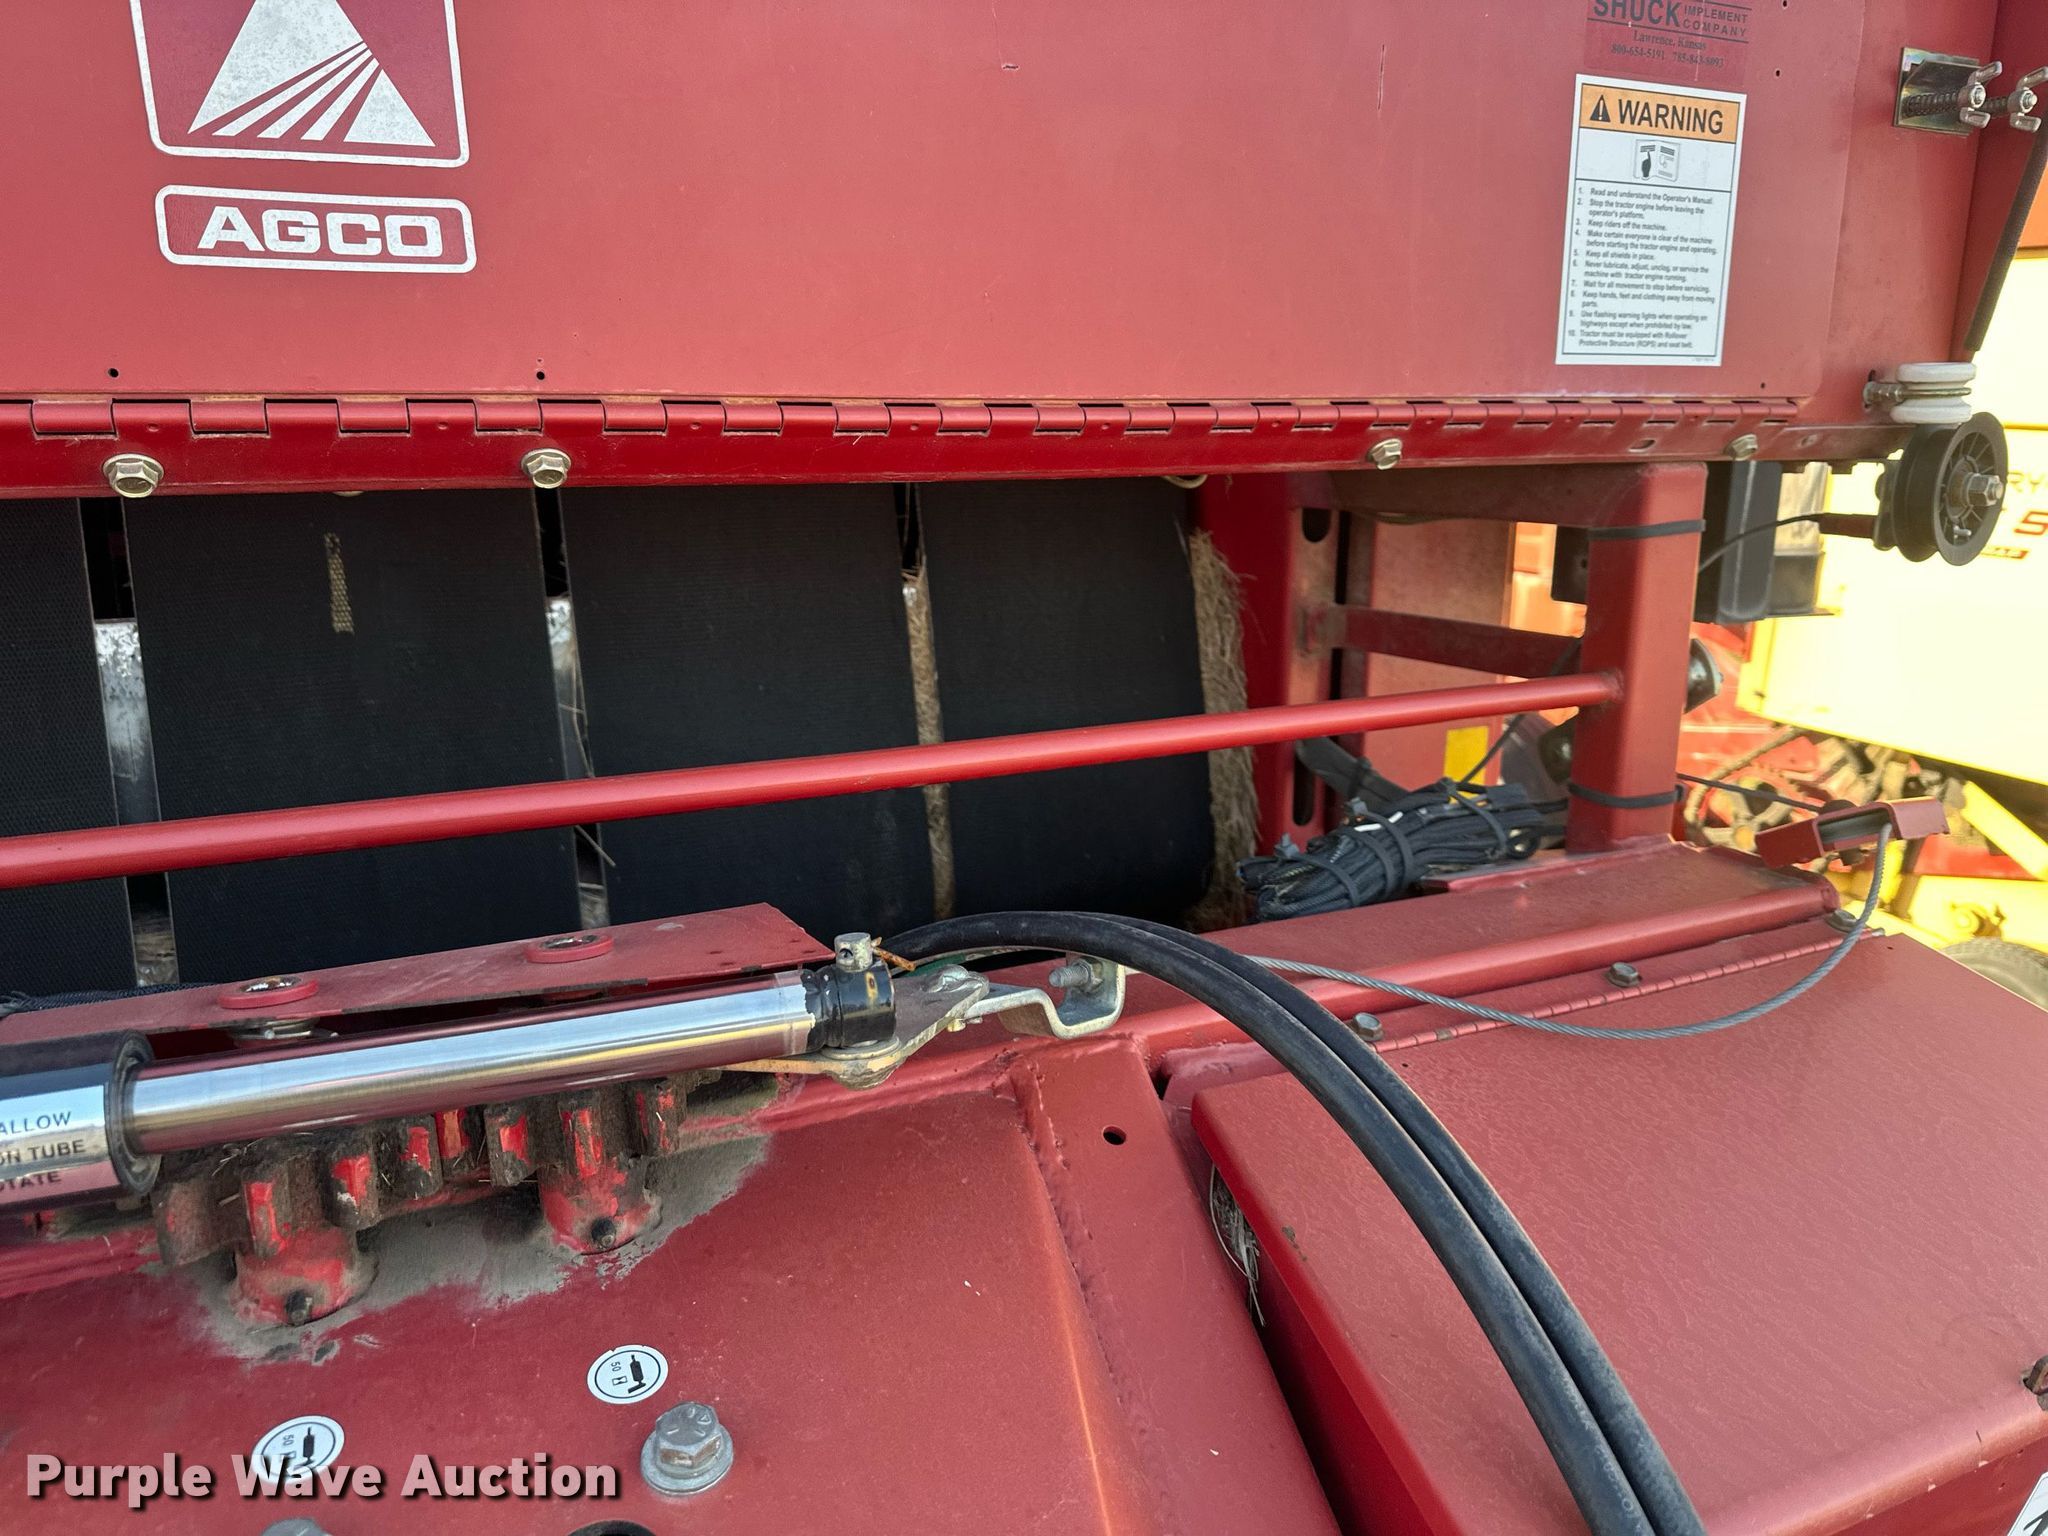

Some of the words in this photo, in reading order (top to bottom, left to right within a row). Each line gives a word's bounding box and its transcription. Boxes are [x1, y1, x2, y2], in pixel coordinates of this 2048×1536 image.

[1594, 0, 1680, 27] SHUCK
[1684, 5, 1748, 23] IMPLEMENT
[1683, 19, 1747, 37] COMPANY
[1634, 30, 1676, 47] Lawrence,
[1678, 37, 1706, 50] Kansas
[1618, 99, 1723, 135] WARNING
[1590, 188, 1605, 196] Read
[1620, 190, 1651, 200] understand
[1663, 194, 1691, 203] Operator's
[1589, 209, 1618, 217] operator's
[1590, 199, 1603, 207] Stop
[1615, 201, 1634, 209] tractor
[1635, 203, 1654, 211] engine
[1655, 203, 1673, 212] before
[1675, 206, 1694, 215] leaving
[197, 206, 443, 257] AGCO
[1588, 220, 1603, 228] Keep
[1605, 220, 1621, 229] riders
[1625, 233, 1651, 241] everyone
[1606, 241, 1628, 249] starting
[1660, 244, 1678, 252] engine
[28, 1139, 86, 1161] TUBE
